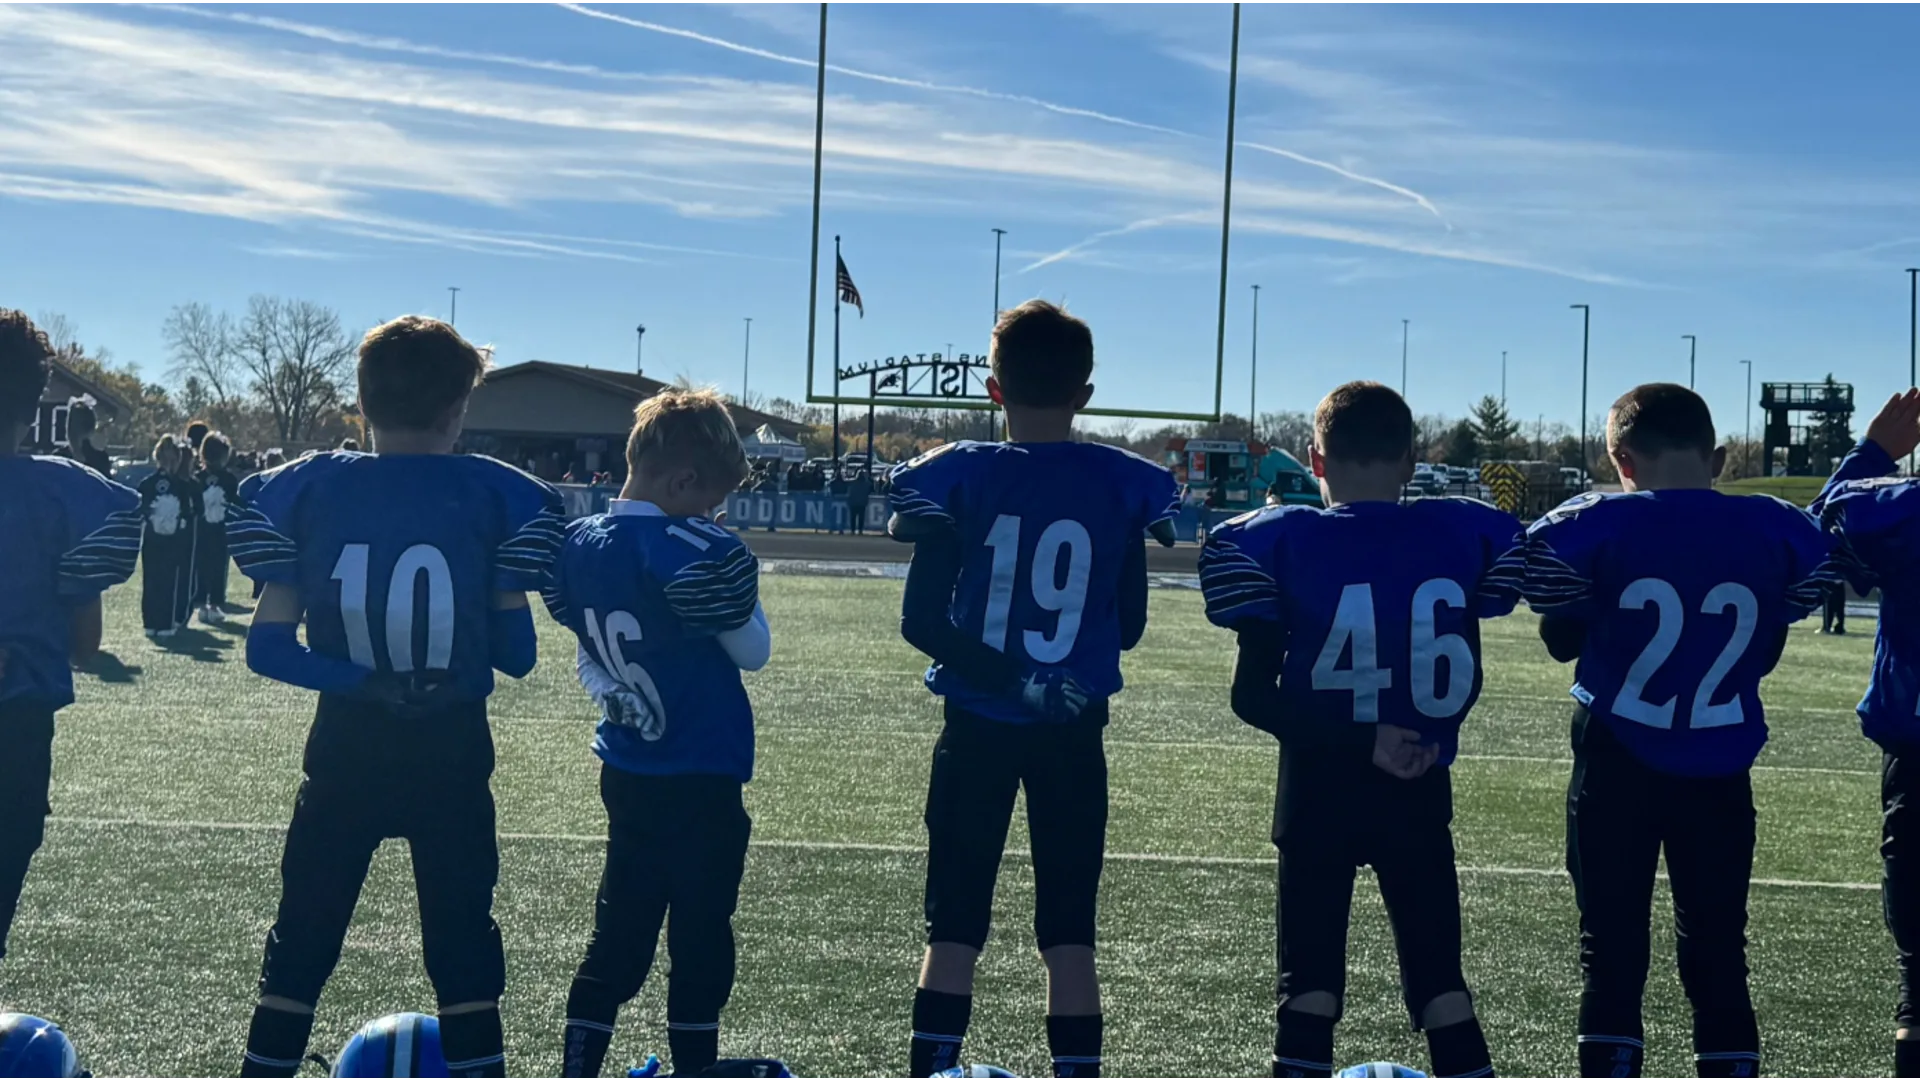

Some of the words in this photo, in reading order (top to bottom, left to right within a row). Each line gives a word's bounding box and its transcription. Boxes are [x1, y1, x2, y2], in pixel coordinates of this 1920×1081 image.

[665, 516, 732, 551] 16
[982, 513, 1092, 664] 19
[330, 543, 454, 671] 10
[584, 607, 666, 741] 16
[1311, 577, 1474, 722] 46
[1610, 577, 1758, 729] 22
